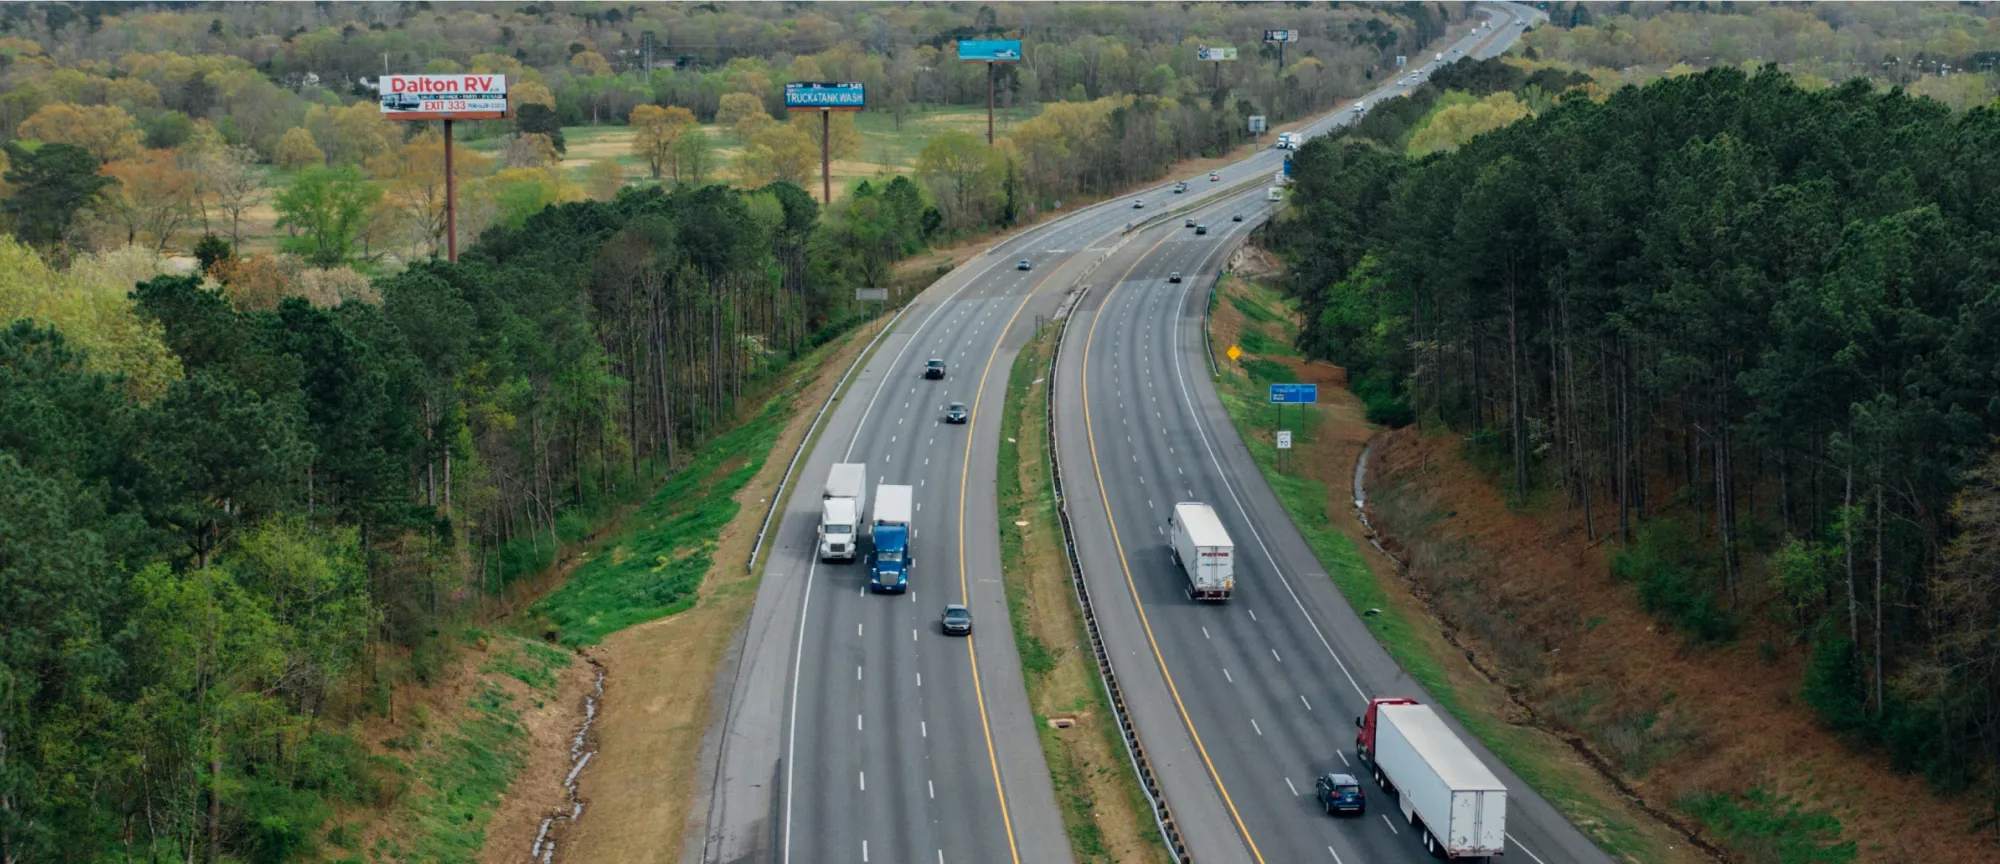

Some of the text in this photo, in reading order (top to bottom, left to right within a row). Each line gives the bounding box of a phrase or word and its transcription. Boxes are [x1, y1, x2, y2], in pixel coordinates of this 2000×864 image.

[391, 77, 493, 92] Dalton RV
[840, 93, 862, 102] WASH
[425, 101, 444, 110] EXIT
[448, 101, 466, 110] 333
